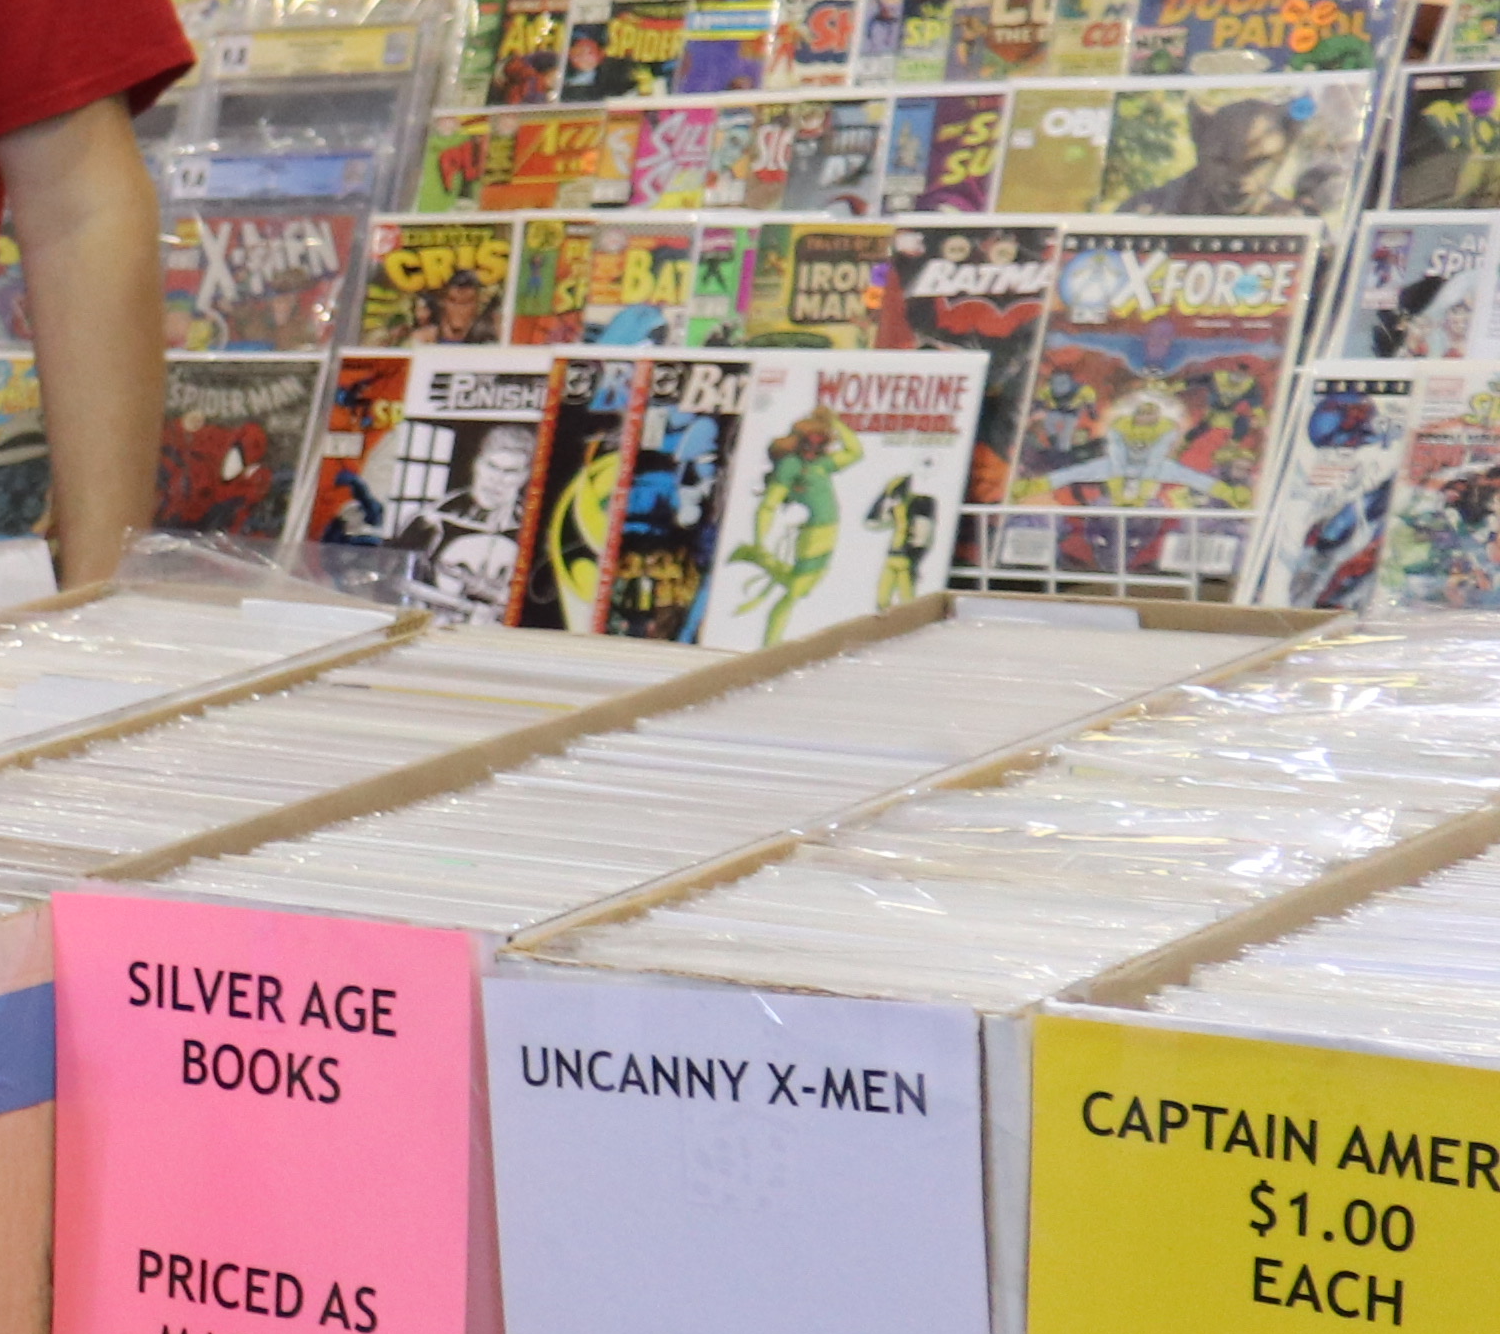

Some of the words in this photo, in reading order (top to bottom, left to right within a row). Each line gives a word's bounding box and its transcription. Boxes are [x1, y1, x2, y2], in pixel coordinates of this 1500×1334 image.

[816, 371, 969, 411] WOLVERINE
[127, 961, 285, 1026] SILVER
[298, 980, 398, 1039] AGE
[180, 1040, 342, 1105] BOOKS
[520, 1044, 749, 1104] UNCANNY
[766, 1062, 930, 1119] X-MEN
[1080, 1089, 1319, 1165] CAPTAIN
[1246, 1179, 1416, 1254] $1.00
[137, 1248, 304, 1321] PRICED
[1251, 1257, 1406, 1327] EACH
